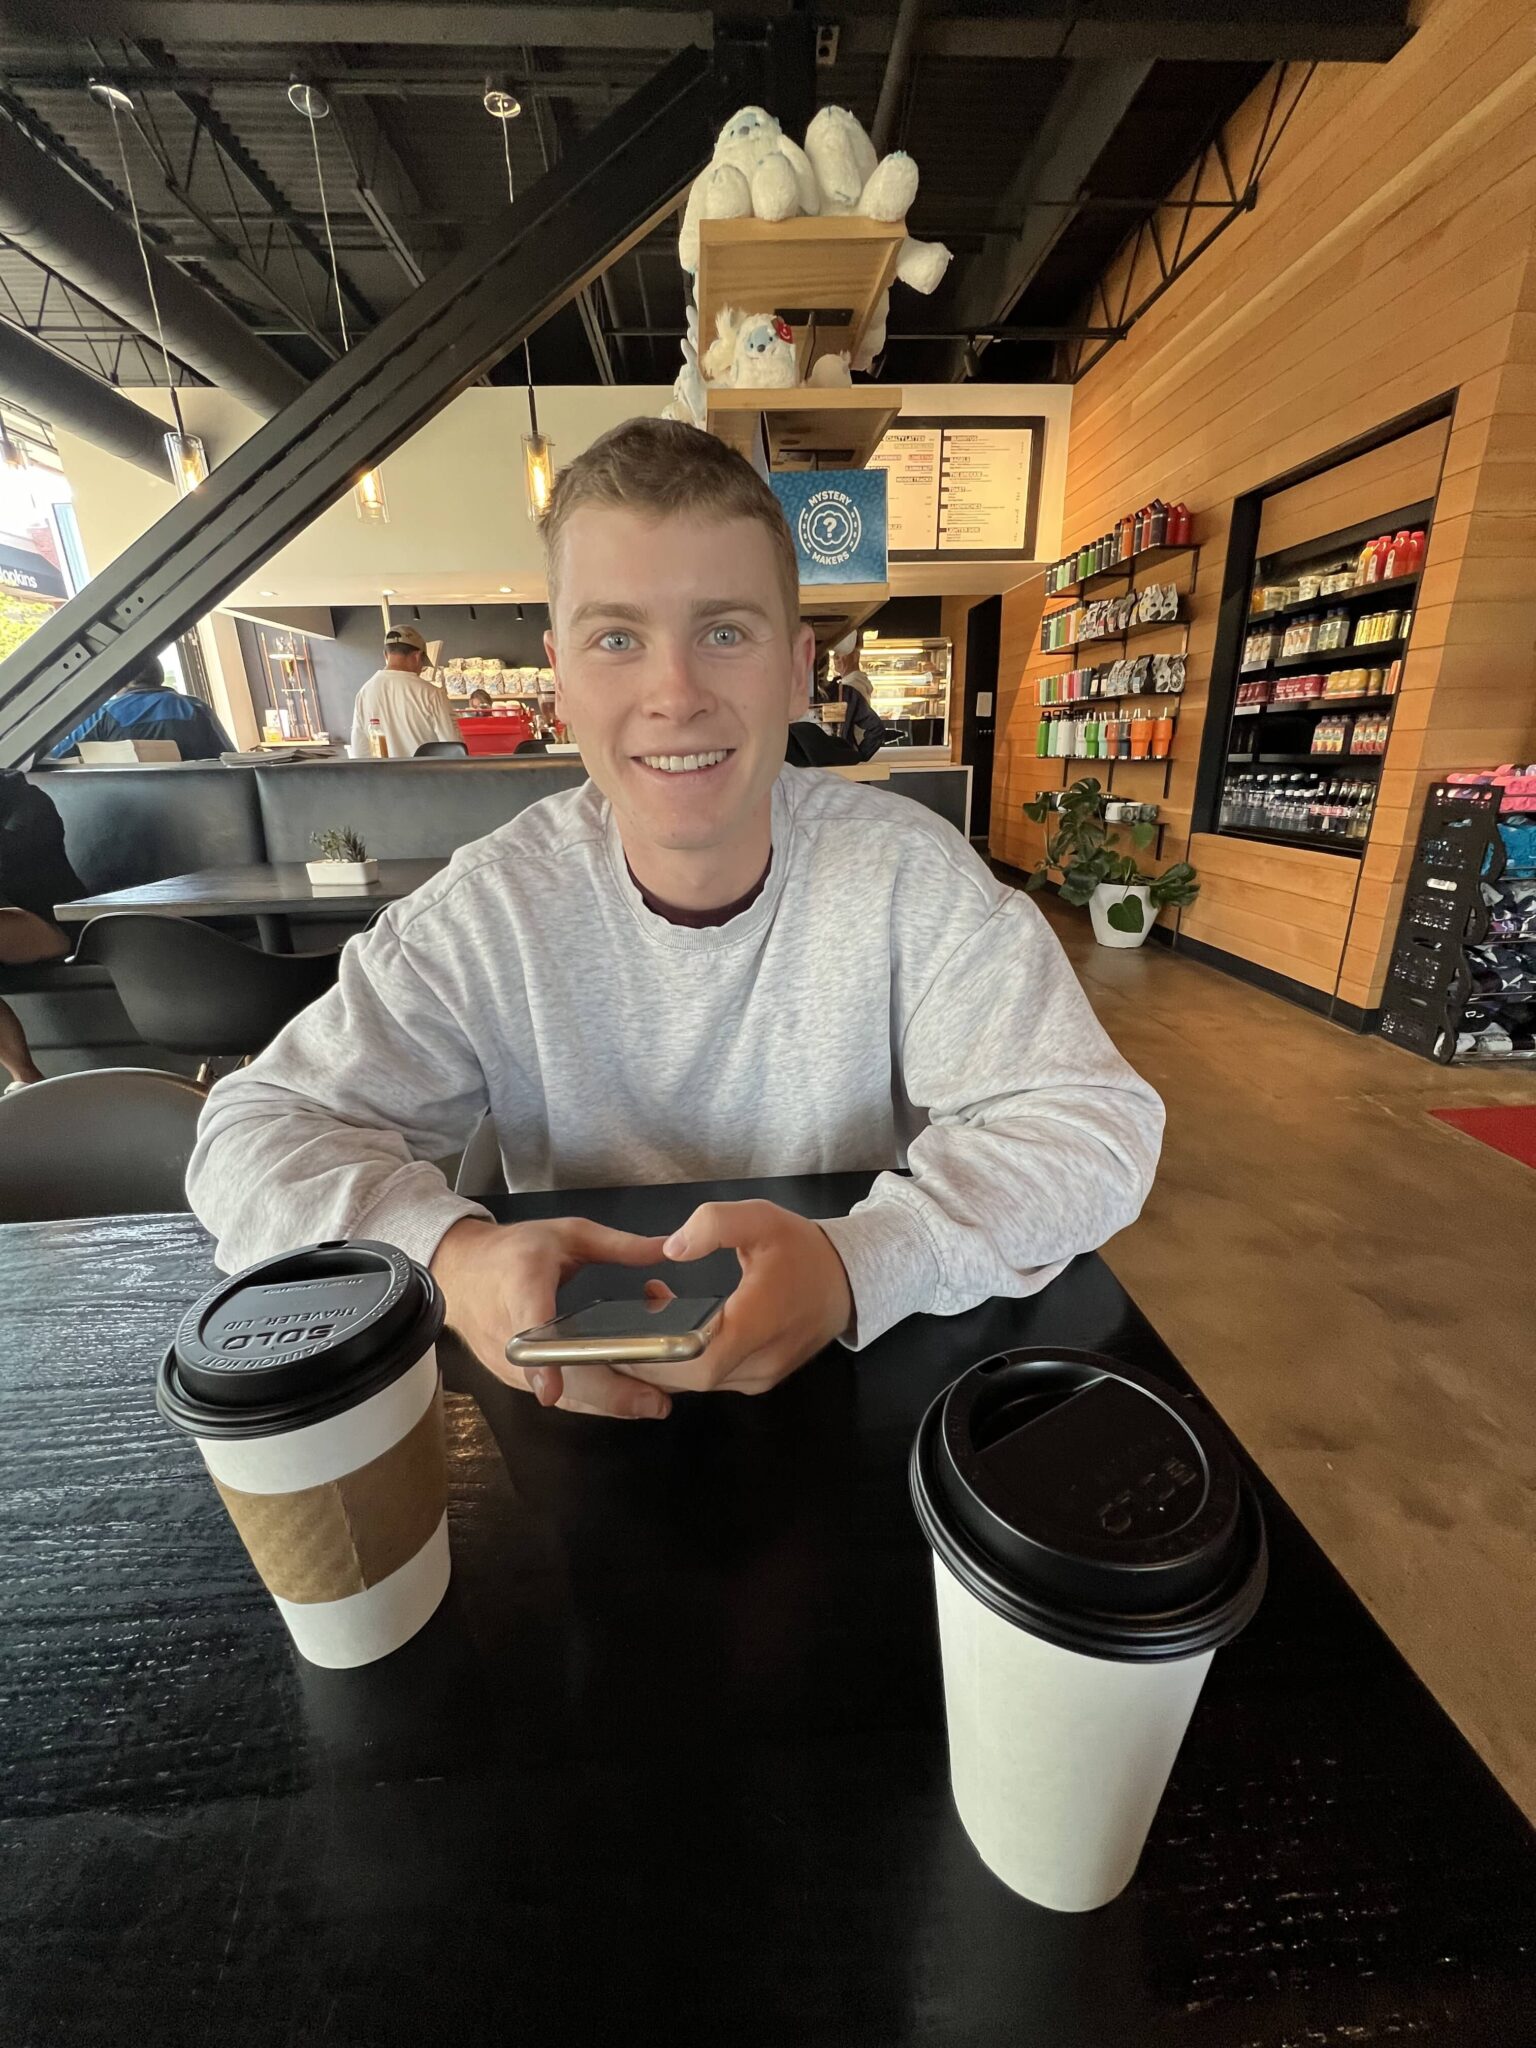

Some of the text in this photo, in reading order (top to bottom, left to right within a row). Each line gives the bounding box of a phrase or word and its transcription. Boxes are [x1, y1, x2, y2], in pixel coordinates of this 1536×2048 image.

[808, 490, 852, 507] MYSTERY
[811, 551, 850, 565] MAKERS
[223, 1307, 358, 1331] TRAVELER LID
[222, 1323, 337, 1351] SOLO
[245, 1340, 334, 1369] CAUTION
